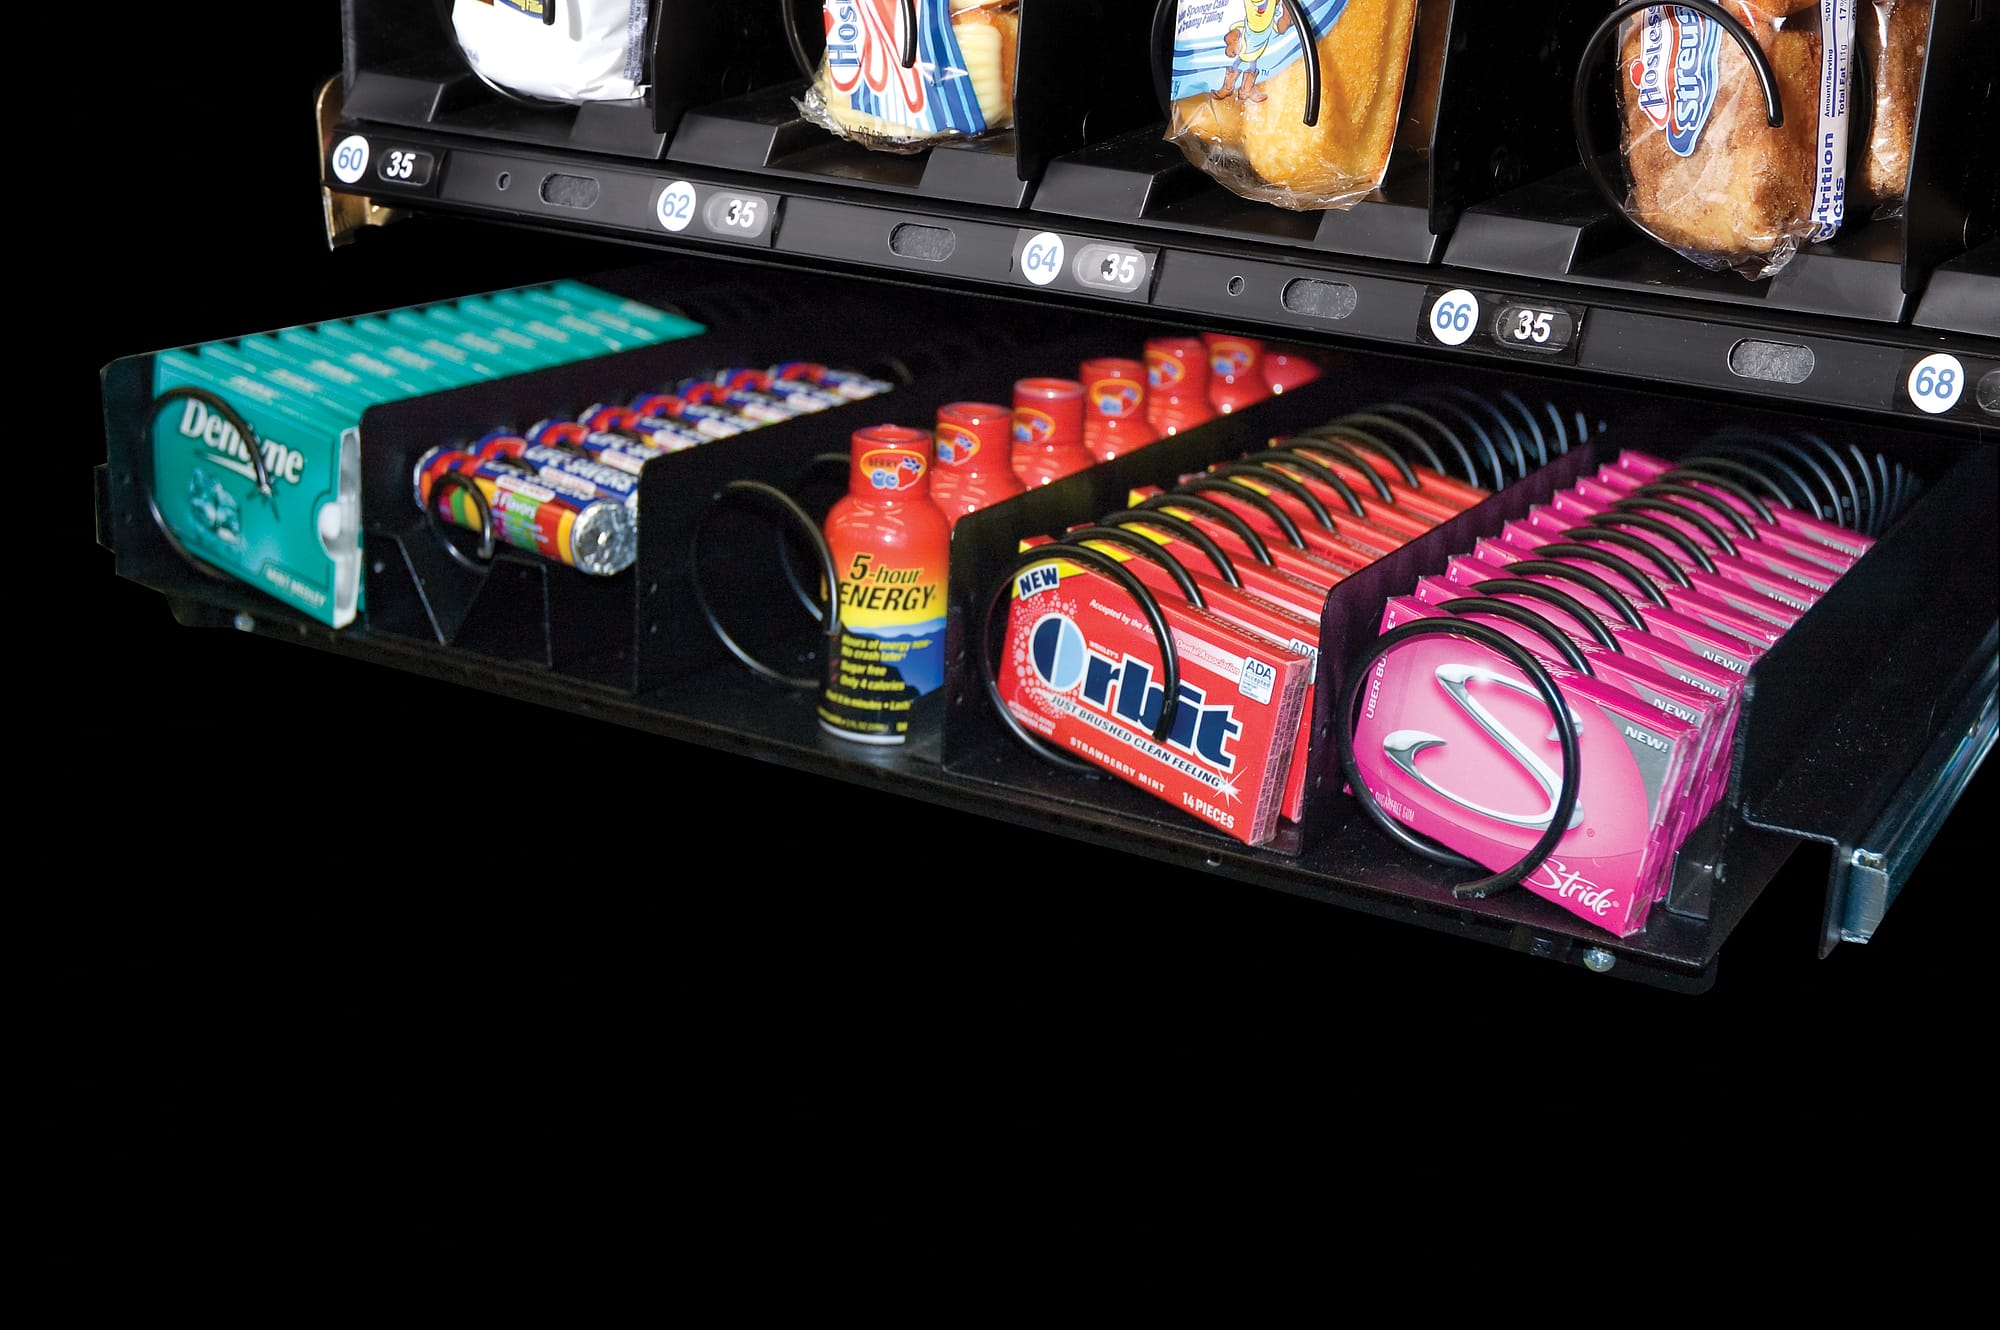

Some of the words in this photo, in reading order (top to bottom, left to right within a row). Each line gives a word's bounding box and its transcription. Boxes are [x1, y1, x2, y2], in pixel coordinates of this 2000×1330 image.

[828, 0, 860, 68] Hos
[1837, 90, 1846, 117] Total
[338, 147, 363, 171] 60
[386, 151, 416, 179] 35
[662, 192, 690, 219] 62
[725, 199, 757, 228] 35
[1026, 244, 1058, 273] 64
[1102, 253, 1138, 284] 35
[1436, 301, 1472, 332] 66
[1513, 309, 1554, 343] 35
[1915, 366, 1956, 400] 68
[850, 554, 921, 585] 5-hour
[1019, 567, 1058, 596] NEW
[840, 582, 936, 611] ENERGY
[1089, 599, 1121, 620] Accepted
[1120, 612, 1132, 625] by
[1130, 617, 1144, 631] the
[1175, 638, 1199, 656] Dental
[1199, 650, 1240, 676] Association
[1246, 660, 1272, 681] ADA
[1031, 615, 1242, 771] Orbit
[1366, 679, 1383, 720] UBER
[1653, 698, 1697, 724] NEW!
[1052, 695, 1077, 712] JUST
[1078, 709, 1132, 742] BRUSHED
[1133, 737, 1171, 762] CLEAN
[1172, 757, 1221, 788] FEELING
[1625, 726, 1669, 754] NEW!
[1069, 736, 1136, 777] STRAWBERRY
[1138, 772, 1166, 793] MINT
[1182, 792, 1196, 809] 14
[1195, 799, 1235, 829] PIECES
[1526, 857, 1615, 917] Stride
